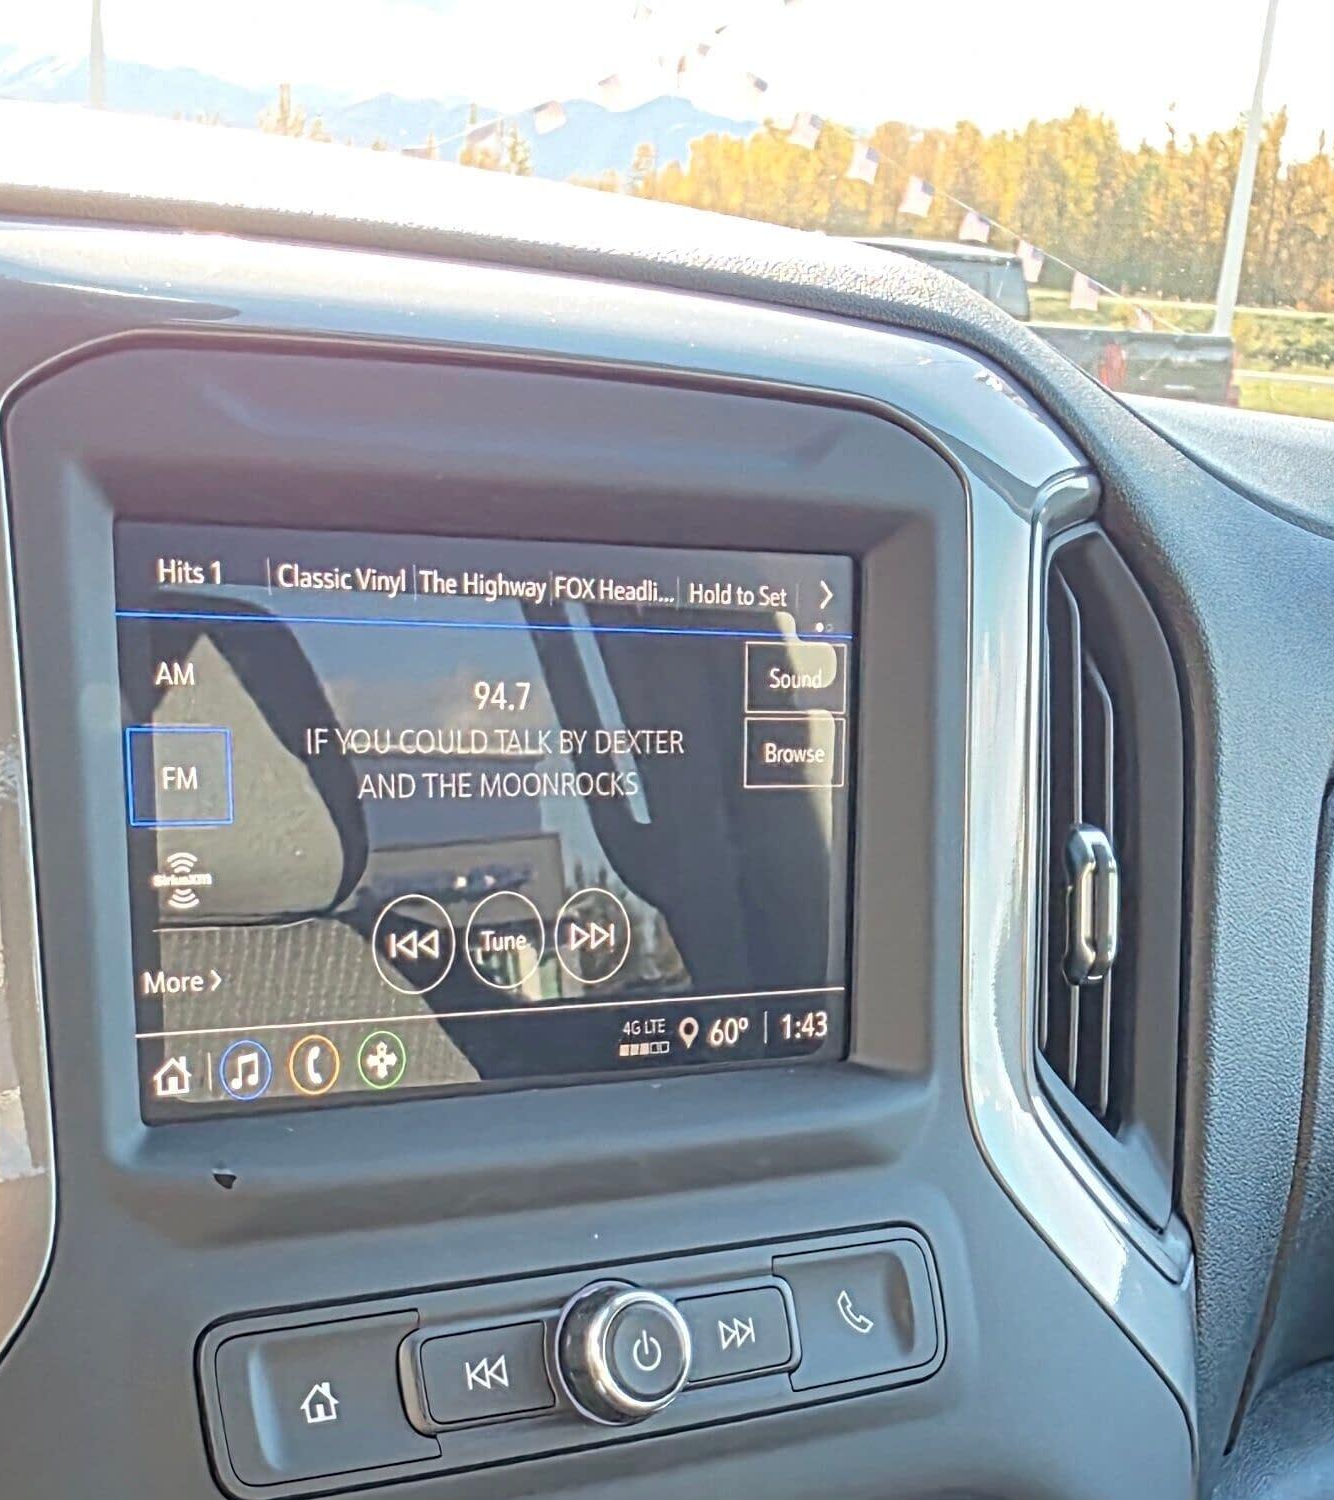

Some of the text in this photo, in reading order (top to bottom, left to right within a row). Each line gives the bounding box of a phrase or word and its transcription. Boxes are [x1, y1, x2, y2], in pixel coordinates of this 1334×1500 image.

[157, 558, 222, 586] Hits 1
[277, 563, 407, 598] Classic Vinyl
[419, 570, 547, 603] The Highway
[554, 576, 675, 604] FOX Headli...
[689, 582, 788, 608] Hold to Set
[155, 662, 196, 686] AM
[769, 668, 823, 690] Sound
[474, 681, 531, 711] 94.7
[306, 727, 684, 755] IF YOU COULD TALK BY DEXTER
[764, 742, 825, 764] Browse
[162, 766, 198, 790] FM
[358, 771, 639, 799] AND THE MOONROCKS
[481, 930, 527, 952] Tune
[143, 970, 204, 994] More
[622, 1018, 666, 1036] 4G LTE
[780, 1010, 828, 1040] 1:43
